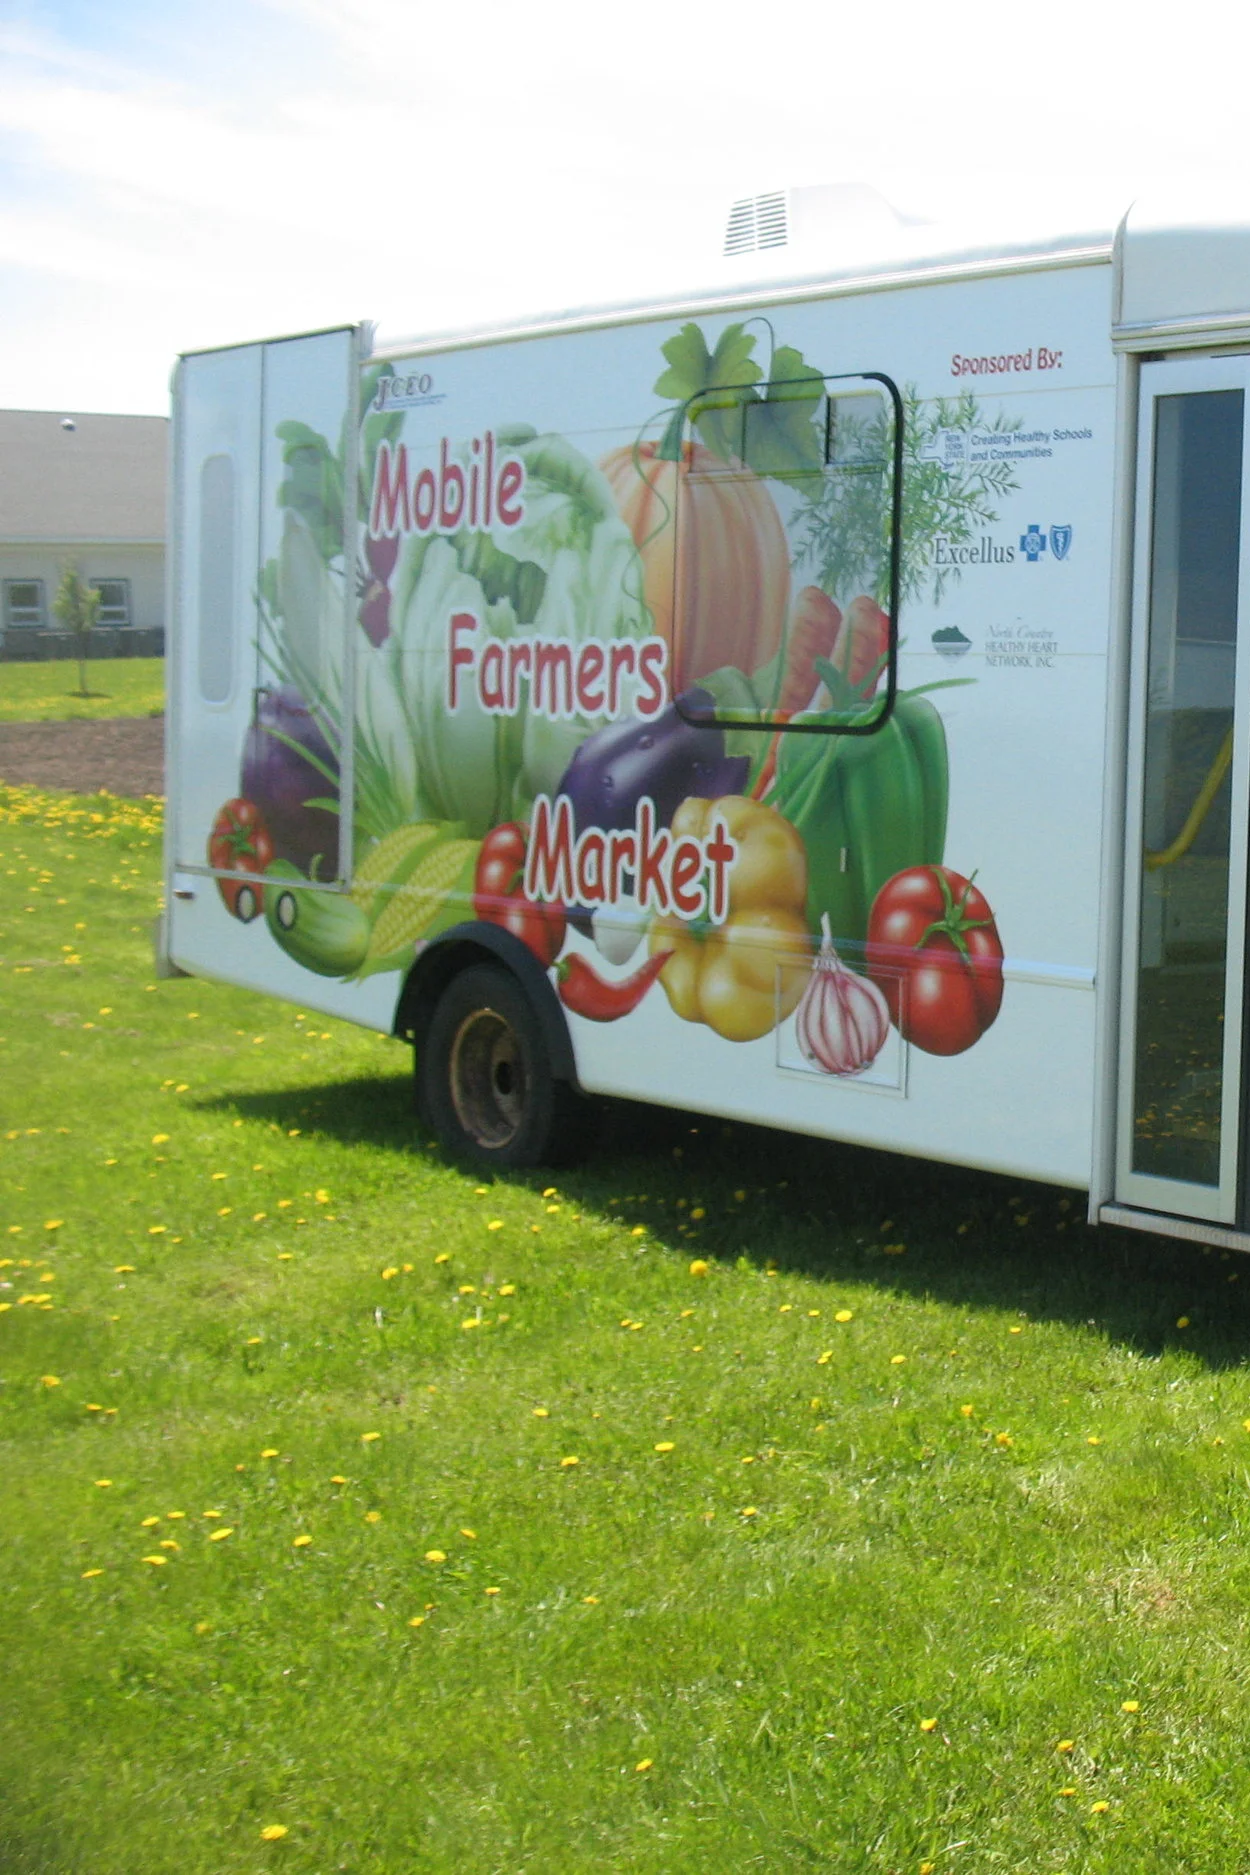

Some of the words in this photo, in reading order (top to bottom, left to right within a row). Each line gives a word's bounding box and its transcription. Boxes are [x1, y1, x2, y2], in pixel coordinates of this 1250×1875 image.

[951, 348, 1032, 376] Sponsored
[1036, 347, 1063, 370] By:
[374, 374, 432, 411] JCEO
[970, 433, 1013, 446] Creating
[1013, 430, 1051, 443] Healthy
[1052, 427, 1093, 441] Schools
[970, 449, 988, 462] and
[990, 446, 1053, 461] Communities
[371, 429, 525, 535] Mobile
[934, 536, 1015, 564] Excellus
[446, 612, 666, 717] Farmers
[527, 799, 736, 919] Market
